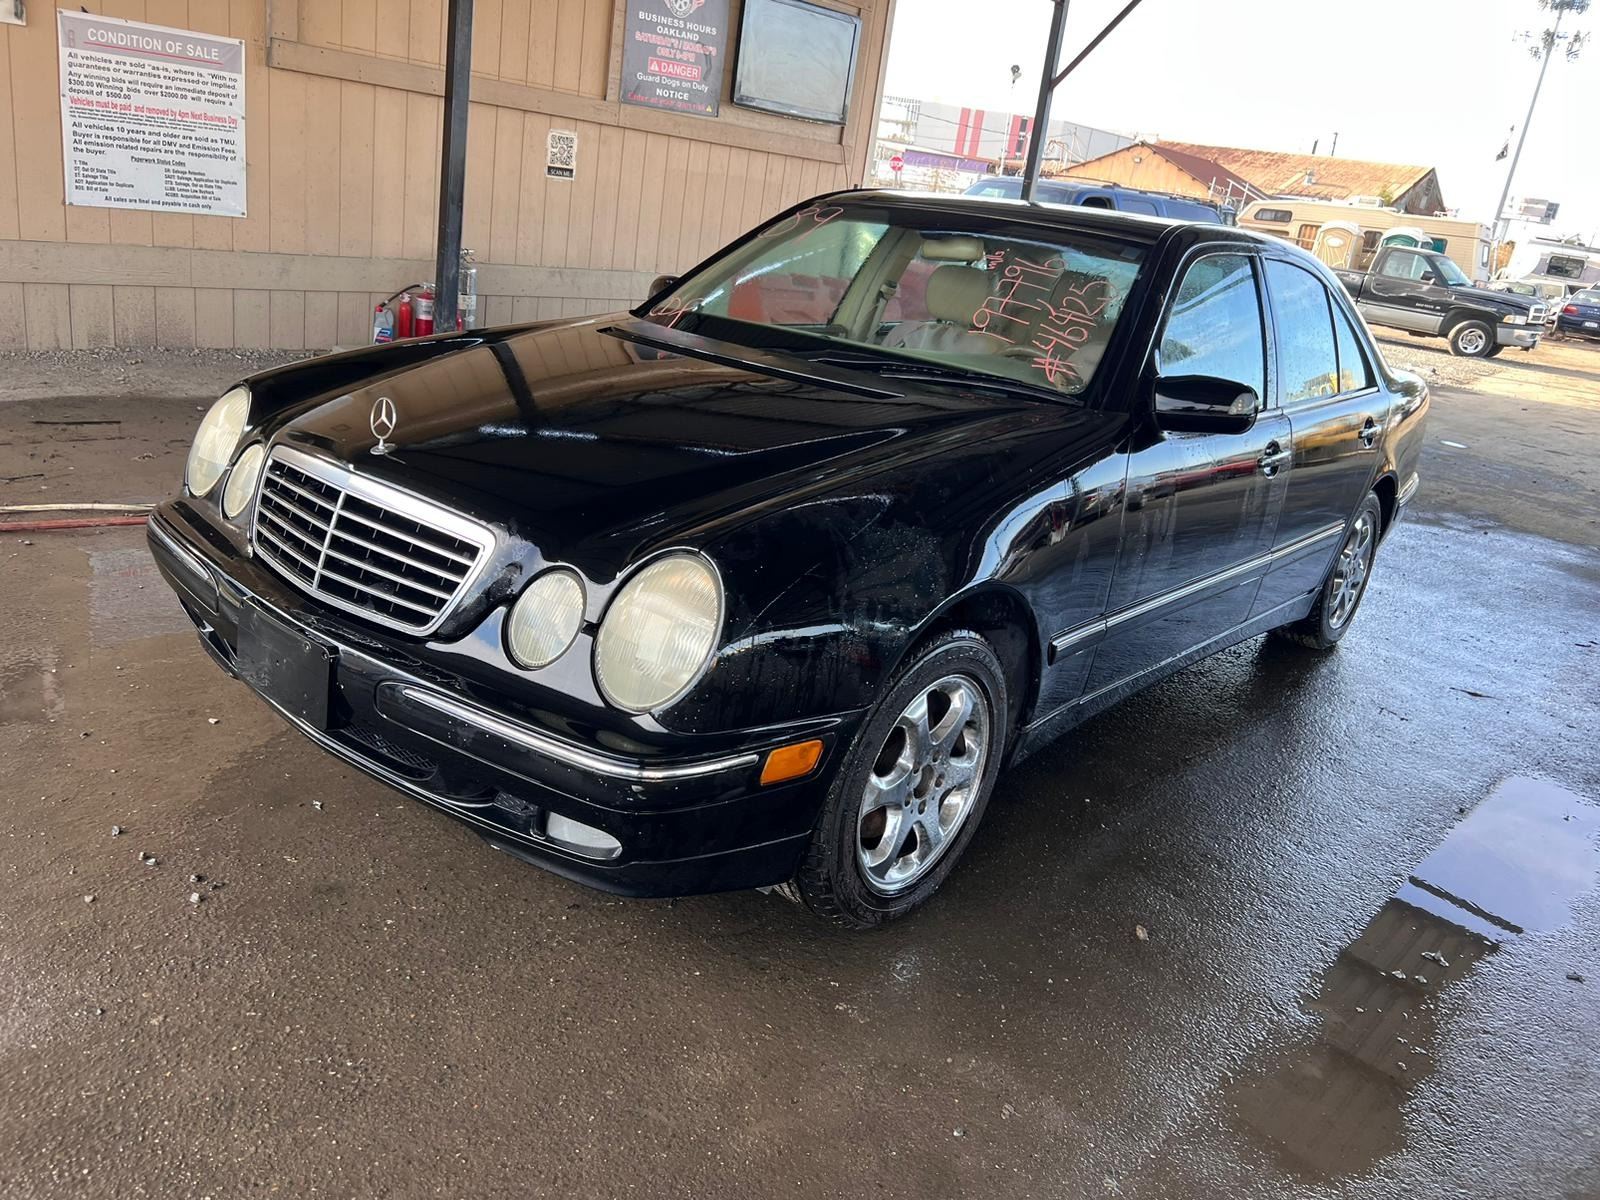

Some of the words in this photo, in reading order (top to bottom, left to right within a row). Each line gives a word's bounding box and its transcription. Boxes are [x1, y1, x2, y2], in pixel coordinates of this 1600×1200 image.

[638, 11, 684, 28] BUSINESS
[686, 22, 717, 35] HOURS
[656, 26, 699, 41] OAKLAND
[88, 28, 162, 51] CONDITION
[166, 41, 183, 54] OF
[187, 44, 219, 60] SALE
[68, 61, 111, 73] guarantees
[123, 68, 161, 79] warranties
[163, 74, 199, 85] expressed
[81, 54, 112, 64] vehicles
[129, 61, 145, 69] sold
[173, 68, 194, 76] where
[661, 64, 698, 78] DANGER
[68, 71, 81, 79] Any
[84, 73, 110, 83] winning
[140, 81, 163, 90] require
[174, 86, 206, 95] immediate
[208, 91, 229, 99] deposit
[68, 78, 94, 88] $300.00
[96, 82, 123, 92] Winning
[160, 91, 187, 100] $2000.00
[205, 98, 226, 106] require
[69, 87, 94, 96] deposit
[106, 91, 131, 100] $500.00
[636, 72, 660, 83] Guard
[661, 77, 680, 88] Dogs
[692, 83, 709, 94] Duty
[656, 88, 689, 101] NOTICE
[70, 96, 94, 107] Vehicles
[95, 100, 110, 109] must
[111, 102, 118, 110] be
[120, 103, 131, 112] paid
[134, 105, 144, 113] and
[146, 106, 169, 116] removed
[171, 110, 177, 119] by
[179, 111, 189, 120] 4pm
[191, 112, 203, 120] Next
[204, 113, 227, 123] Business
[228, 117, 237, 126] Day
[84, 123, 114, 131] vehicles
[72, 130, 93, 139] Buyer
[102, 134, 140, 144] responsible
[192, 144, 219, 152] Emission
[84, 140, 114, 148] emission
[116, 143, 138, 151] related
[140, 146, 162, 154] repairs
[189, 151, 228, 161] responsibility
[131, 156, 155, 165] Paperwork
